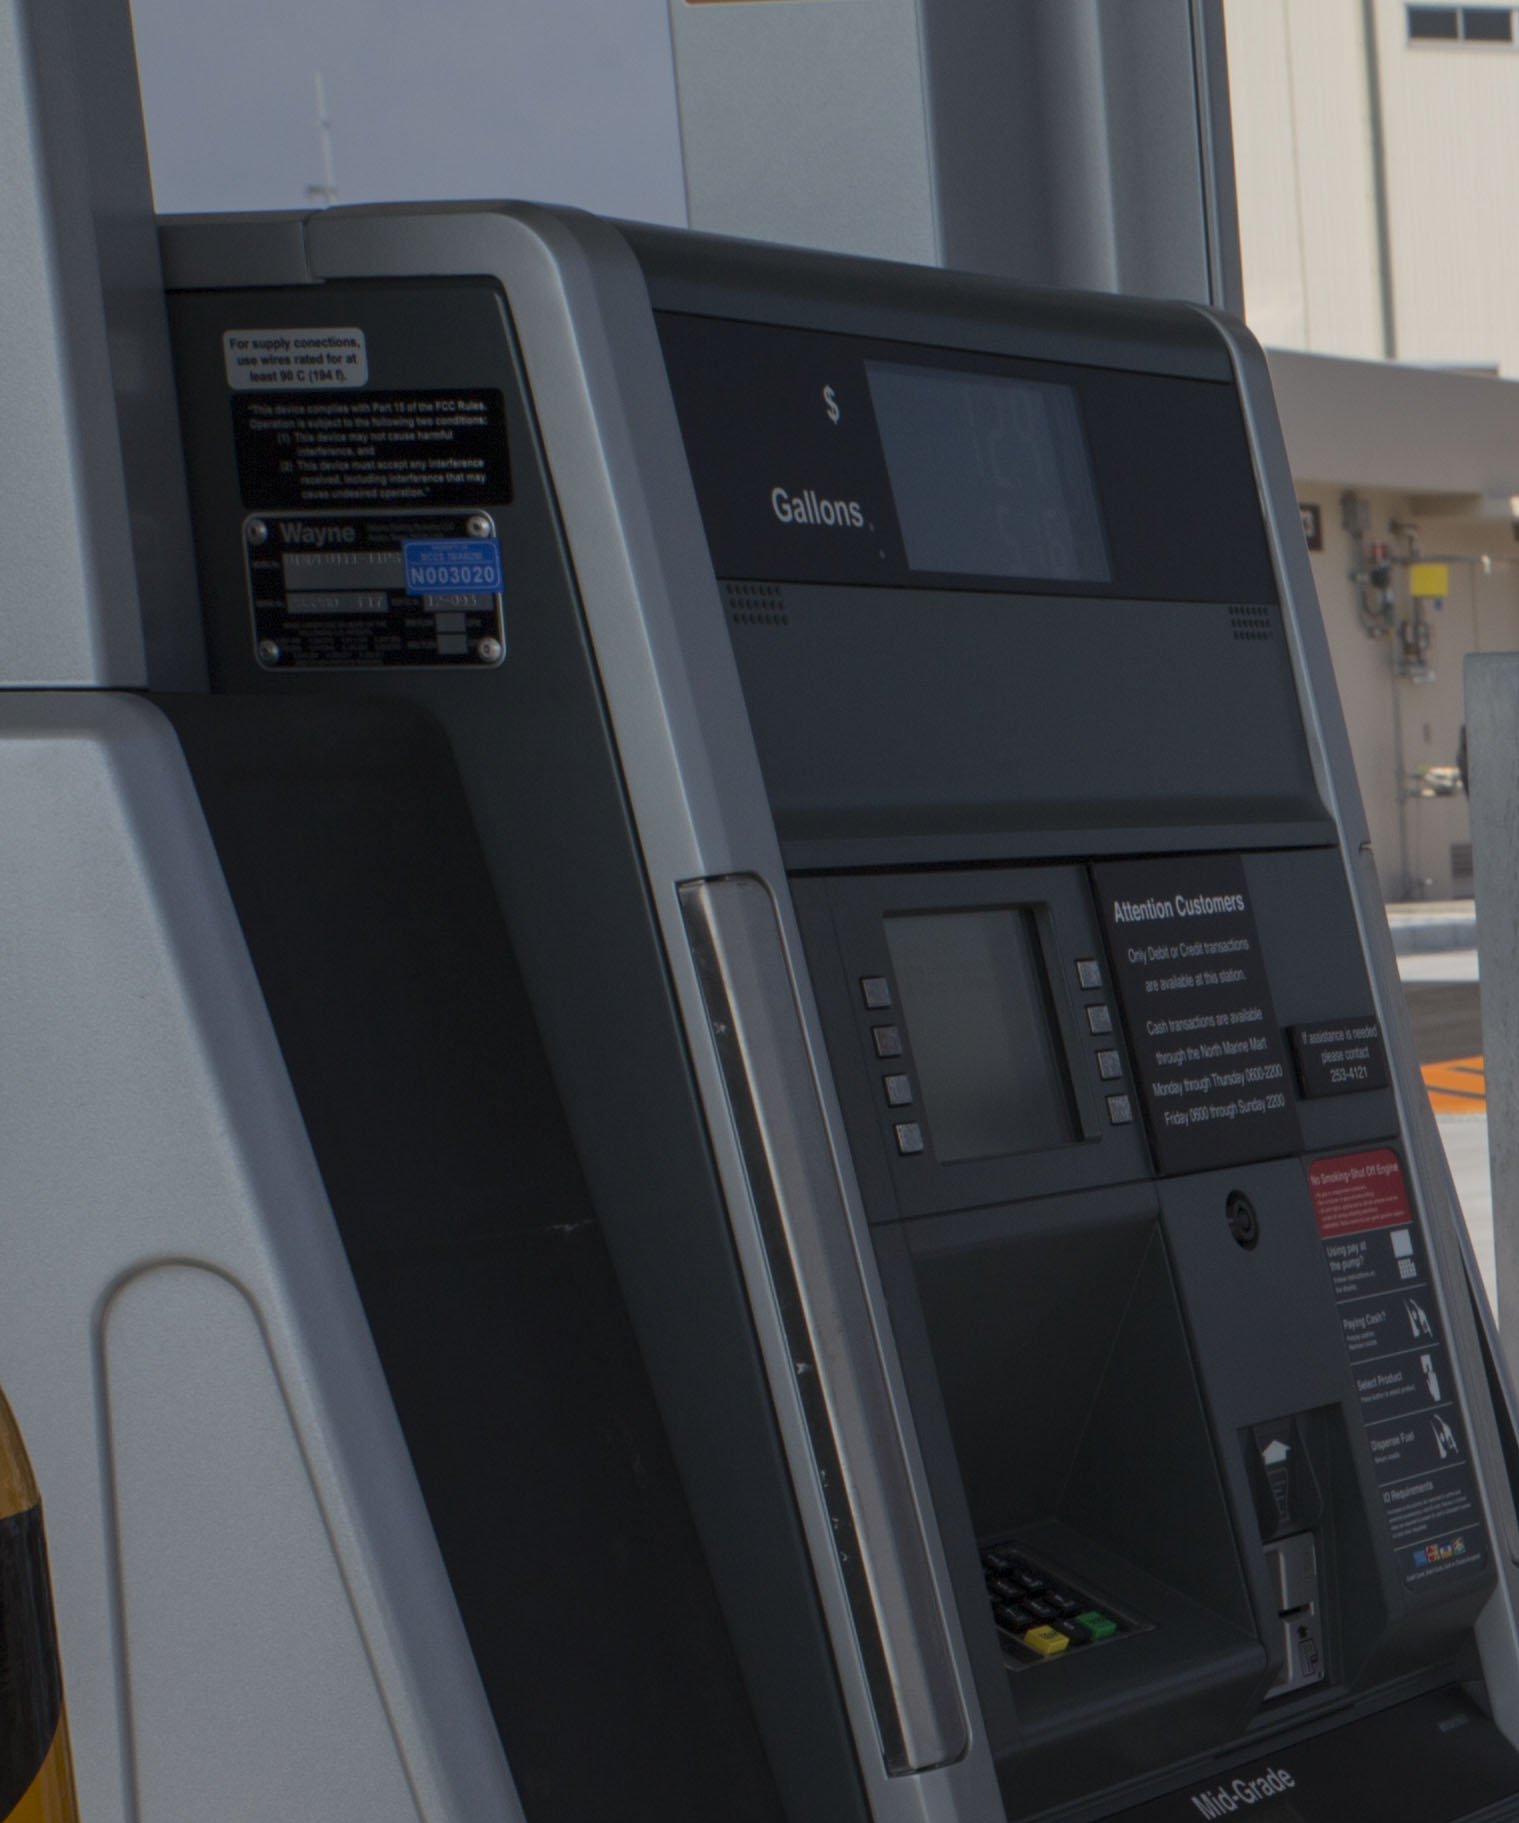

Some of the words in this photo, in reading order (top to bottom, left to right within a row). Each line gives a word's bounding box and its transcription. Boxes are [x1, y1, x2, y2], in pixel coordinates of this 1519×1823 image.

[251, 338, 290, 352] supply
[293, 352, 324, 365] rated
[345, 354, 357, 365] at
[296, 369, 305, 381] C
[823, 384, 840, 426] $
[771, 486, 864, 527] Gallons
[280, 521, 355, 548] Wayne
[411, 565, 495, 586] N003020
[1113, 897, 1175, 924] Attention
[1174, 893, 1246, 918] Customers
[1127, 947, 1148, 966] Only
[1147, 945, 1171, 961] Debit
[1170, 945, 1180, 960] or
[1179, 942, 1205, 959] Credit
[1204, 938, 1250, 955] transactions
[1144, 980, 1160, 993] are
[1159, 973, 1196, 991] available
[1194, 973, 1205, 987] at
[1203, 971, 1220, 985] this
[1146, 1020, 1169, 1037] Cash
[1168, 1014, 1217, 1033] transactions
[1216, 1013, 1231, 1027] are
[1229, 1006, 1264, 1024] available
[1309, 1030, 1345, 1045] assistance
[1344, 1029, 1353, 1042] is
[1352, 1025, 1379, 1041] needed
[1155, 1049, 1188, 1067] through
[1187, 1046, 1202, 1061] the
[1200, 1042, 1224, 1059] North
[1222, 1039, 1250, 1056] Marine
[1249, 1035, 1269, 1052] Mart
[1320, 1049, 1345, 1066] please
[1344, 1046, 1369, 1061] contact
[1152, 1081, 1185, 1097] Monday
[1183, 1077, 1212, 1094] through
[1211, 1071, 1246, 1089] Thursday
[1330, 1065, 1369, 1083] 253-4121
[1163, 1110, 1189, 1127] Friday
[1209, 1102, 1239, 1120] through
[1237, 1097, 1267, 1115] Sunday
[1310, 1174, 1321, 1185] No
[1365, 1164, 1378, 1177] Off
[1376, 1162, 1399, 1177] Engine
[1326, 1246, 1348, 1258] Using
[1346, 1243, 1360, 1257] pay
[1329, 1260, 1342, 1272] the
[1341, 1256, 1364, 1273] pump?
[1343, 1317, 1367, 1332] Paying
[1365, 1311, 1387, 1326] Cash?
[1356, 1378, 1379, 1392] Select
[1377, 1371, 1403, 1386] Product
[1370, 1436, 1401, 1452] Dispense
[1399, 1431, 1416, 1445] Fuel
[1391, 1480, 1435, 1501] Requirements
[1191, 1767, 1296, 1821] Mid-Grade
